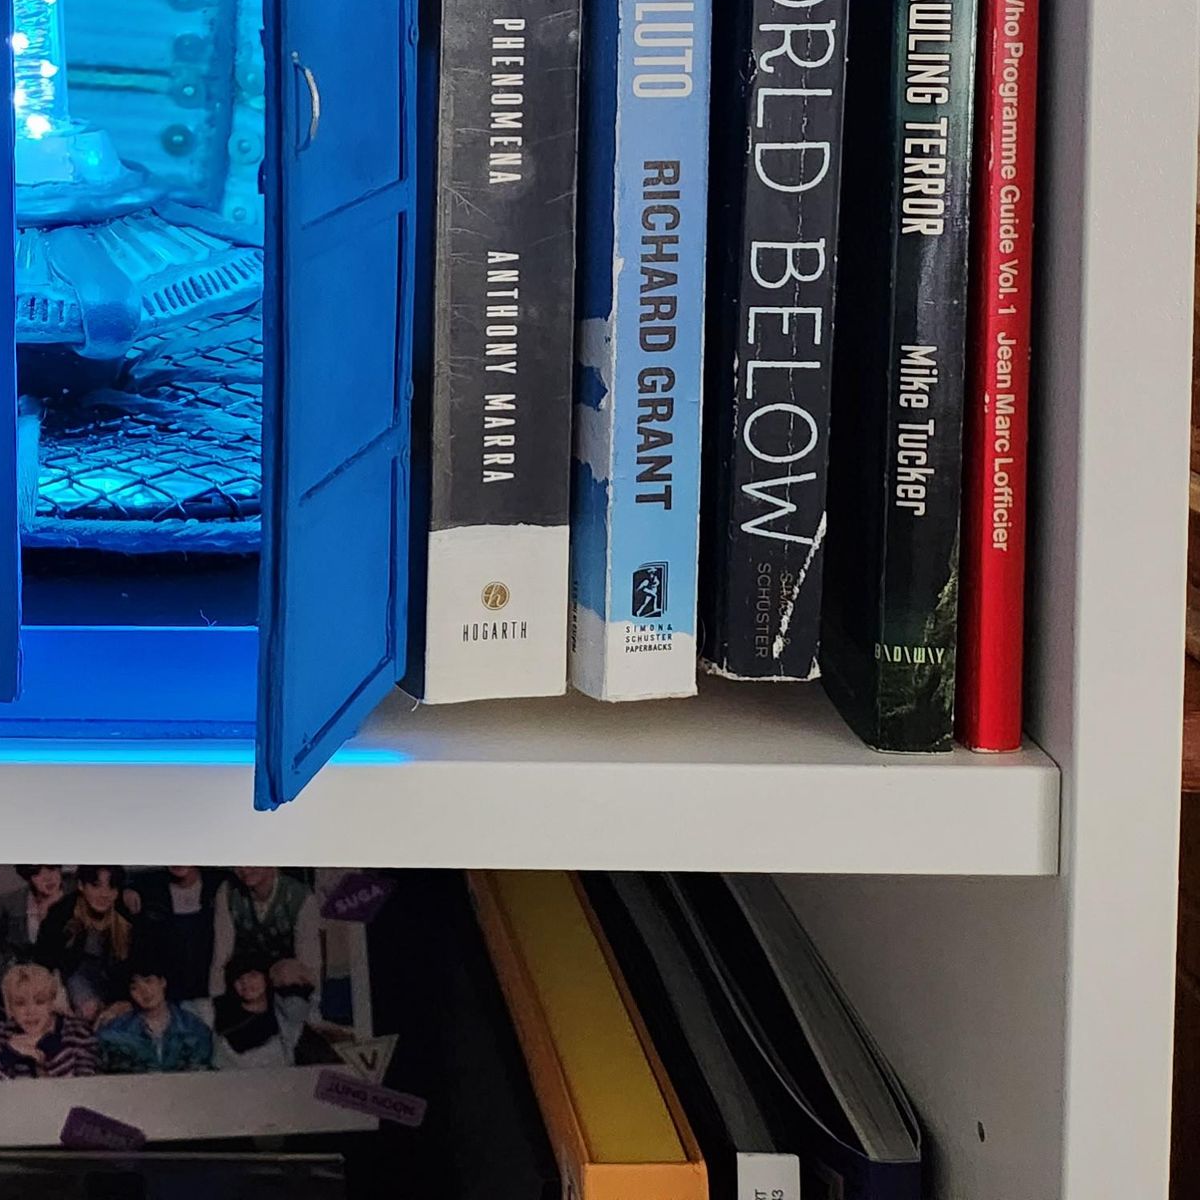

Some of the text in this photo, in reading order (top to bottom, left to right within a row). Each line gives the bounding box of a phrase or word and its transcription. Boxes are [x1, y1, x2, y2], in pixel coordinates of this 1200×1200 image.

[488, 18, 526, 185] PHENOMENA
[999, 42, 1024, 180] Programme
[901, 115, 950, 237] TERROR
[999, 185, 1021, 254] Guide
[998, 259, 1019, 300] Vol.
[998, 305, 1017, 315] 1
[482, 250, 520, 484] ANTHONY MARRA
[635, 160, 681, 510] RICHARD GRANT
[741, 237, 827, 546] BELOW
[896, 344, 938, 517] Mike Tucker
[992, 331, 1017, 552] Jean Marc Lofficier
[462, 621, 528, 642] HOGARTH
[625, 624, 664, 633] SIMON
[625, 634, 673, 643] SCHUSTER
[625, 644, 672, 653] PAPERBACKS
[754, 562, 772, 658] SCHUSTER
